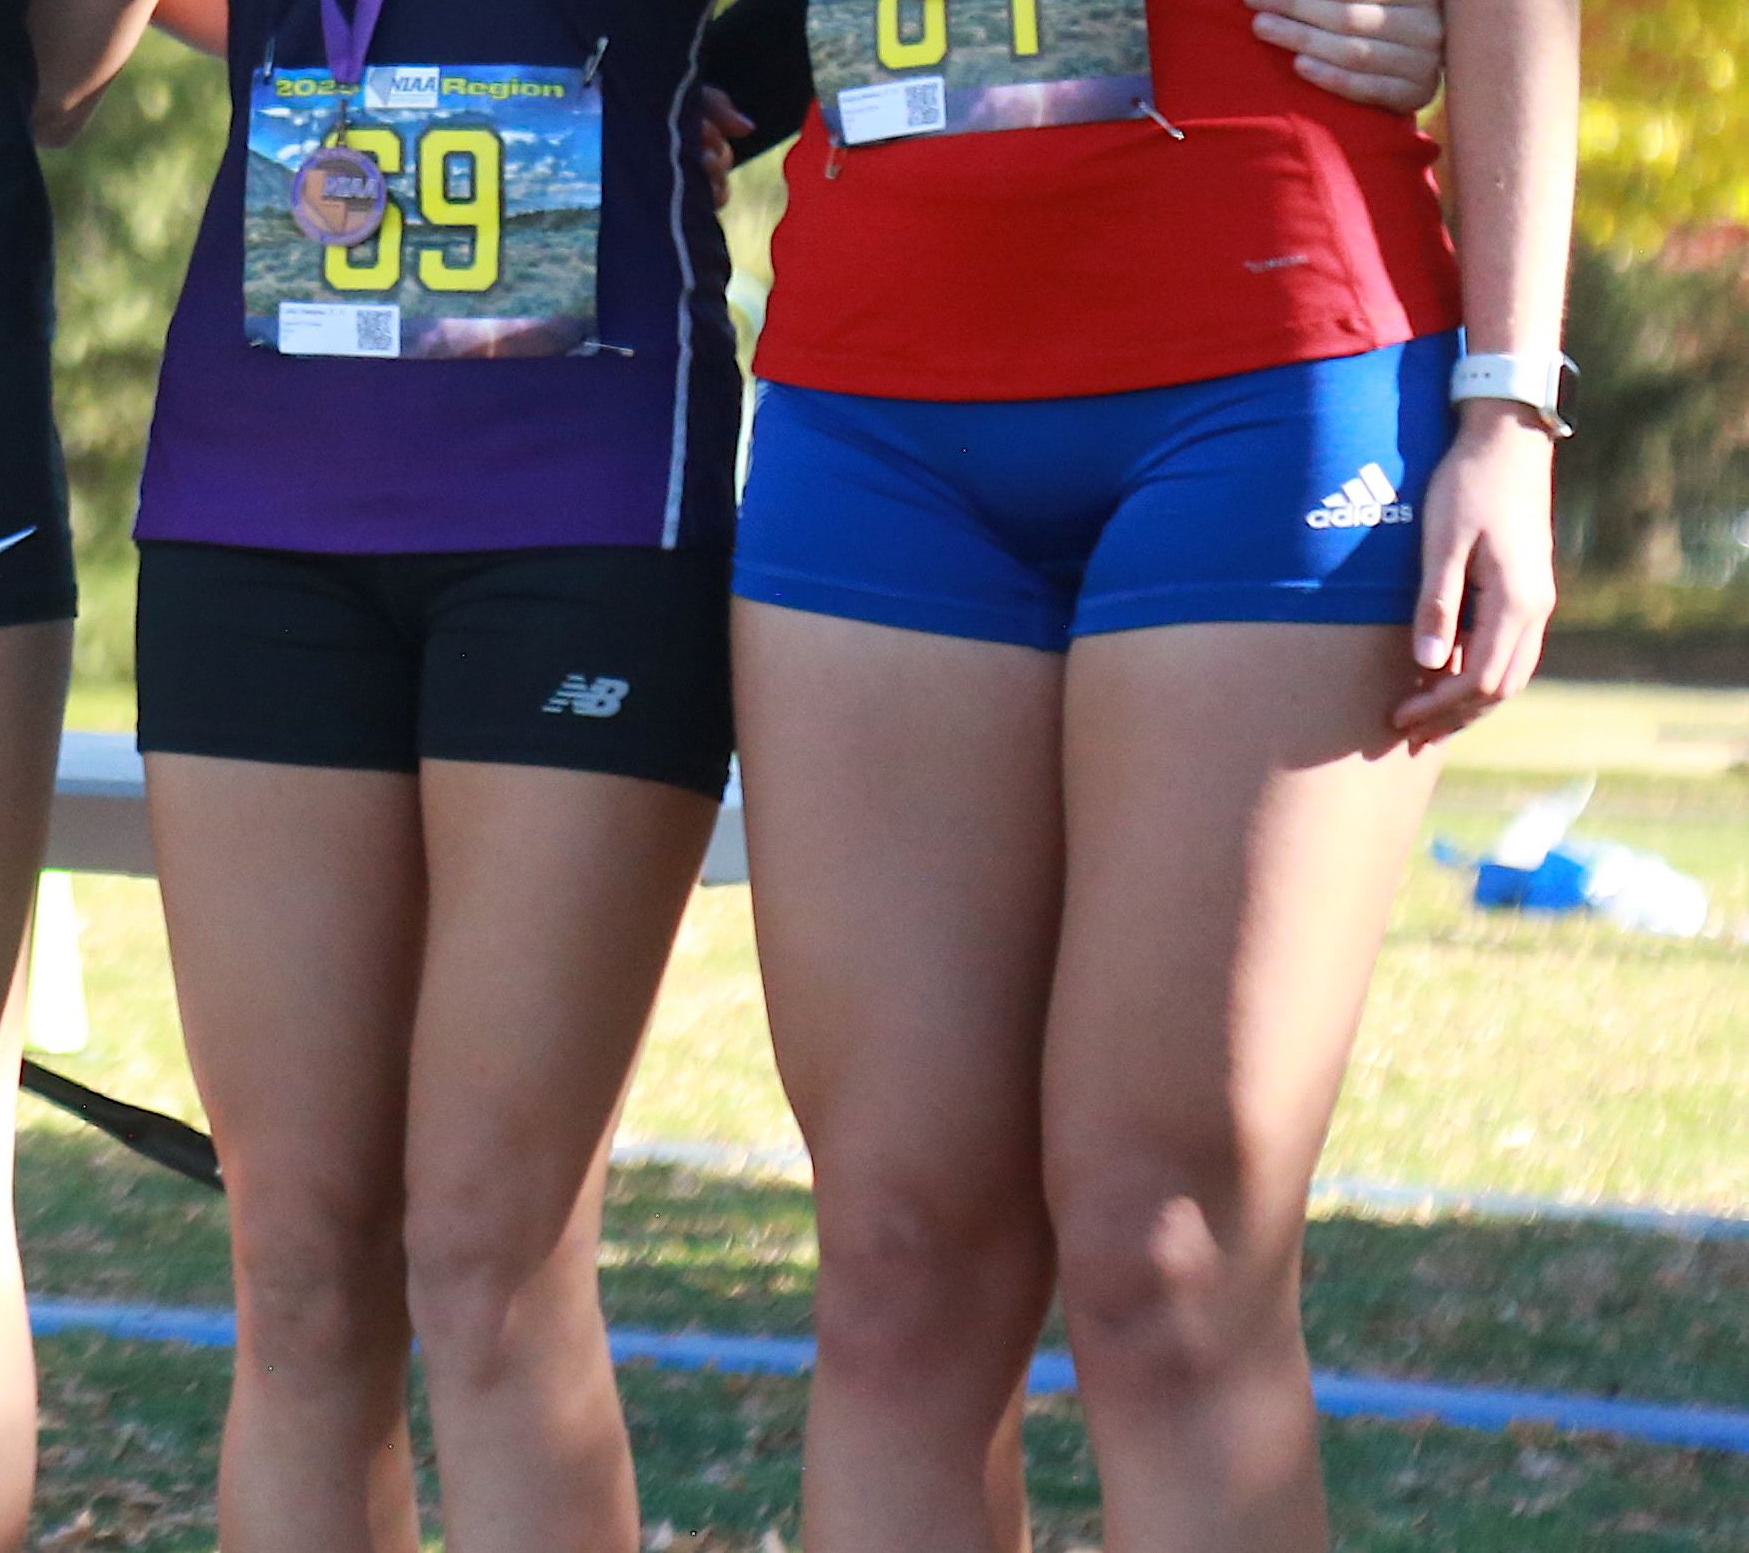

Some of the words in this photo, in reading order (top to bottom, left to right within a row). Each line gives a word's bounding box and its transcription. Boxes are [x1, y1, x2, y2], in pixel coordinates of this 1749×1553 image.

[391, 75, 437, 93] NIAA
[442, 76, 566, 100] Region
[324, 129, 501, 291] 69
[1306, 502, 1413, 529] adidas
